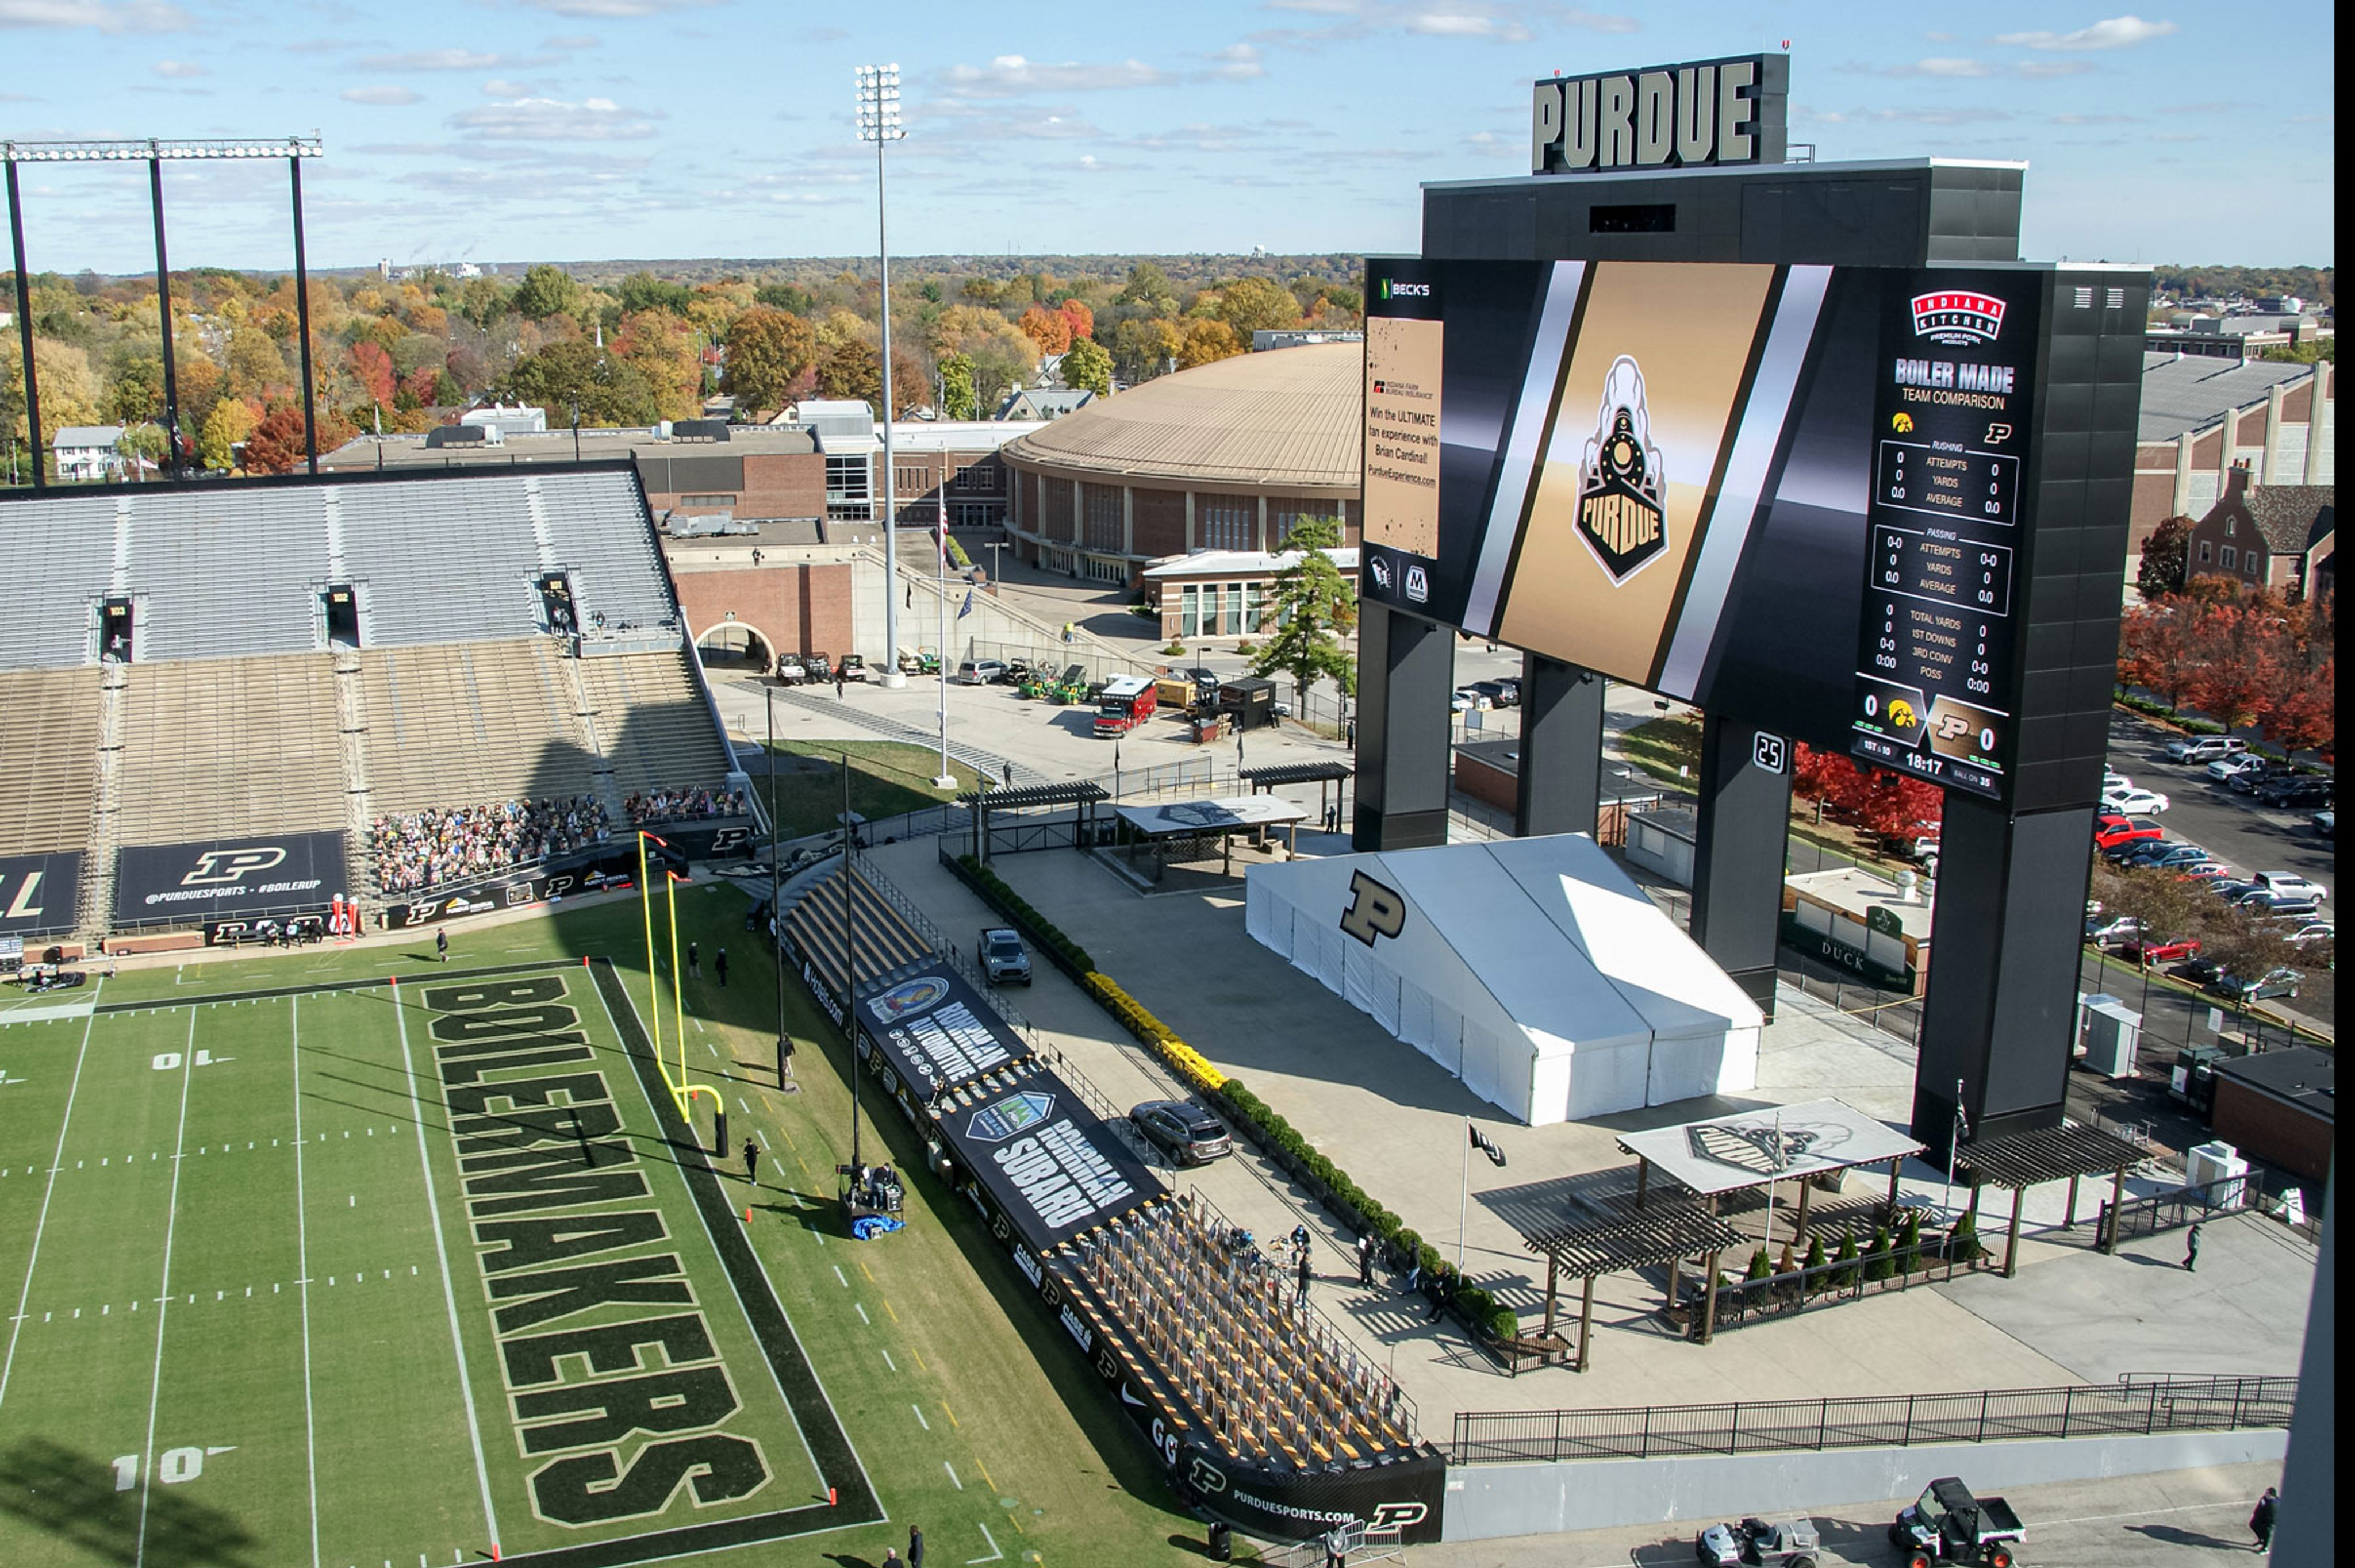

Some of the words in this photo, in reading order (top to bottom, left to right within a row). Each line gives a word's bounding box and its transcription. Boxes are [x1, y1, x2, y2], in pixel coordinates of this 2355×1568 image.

[1533, 61, 1754, 170] PURDUE
[1393, 284, 1429, 296] BECK'S
[1917, 297, 1997, 316] INDIANA
[1920, 314, 1995, 333] KITCHEN
[1895, 358, 1954, 388] BOILER
[1958, 363, 2014, 393] MADE
[1902, 388, 1931, 402] TEAM
[1932, 391, 2005, 410] COMPARISON
[1370, 406, 1383, 419] Win
[1384, 409, 1396, 421] the
[1398, 410, 1436, 427] ULTIMATE
[1381, 428, 1421, 444] experience
[1422, 434, 1438, 447] with
[1984, 423, 2012, 444] P
[1375, 444, 1394, 458] Brian
[1932, 440, 1963, 453] RUSHING
[1897, 451, 1905, 464] 0
[1926, 456, 1967, 471] ATTEMPTS
[1368, 464, 1436, 487] PurdueExperience.com
[1895, 469, 1903, 481] 0
[1991, 463, 1999, 476] 0
[1932, 476, 1958, 489] YARDS
[1990, 482, 1998, 495] 0
[1891, 486, 1906, 499] 0.0
[1926, 493, 1963, 508] AVERAGE
[1985, 501, 2001, 514] 0.0
[1583, 494, 1659, 555] PURDUE
[1887, 536, 1903, 549] 0-0
[1927, 528, 1956, 541] PASSING
[1919, 543, 1961, 559] ATTEMPTS
[1889, 554, 1897, 566] 0
[1980, 552, 1997, 567] 0-0
[1927, 562, 1953, 575] YARDS
[1885, 570, 1899, 584] 0.0
[1983, 572, 1991, 585] 0
[1919, 579, 1957, 595] AVERAGE
[1978, 590, 1994, 604] 0.0
[1886, 604, 1894, 616] 0
[1885, 621, 1893, 633] 0
[1910, 610, 1934, 625] TOTAL
[1935, 616, 1962, 631] YARDS
[1979, 625, 1986, 637] 0
[1880, 637, 1896, 651] 0-0
[1926, 632, 1957, 648] DOWNS
[1912, 647, 1928, 659] 3RD
[1929, 651, 1954, 664] CONV
[1977, 643, 1985, 656] 0
[1875, 654, 1897, 669] 0:00
[1971, 660, 1988, 675] 0-0
[1920, 666, 1942, 680] POSS
[1967, 677, 1990, 694] 0:00
[1864, 694, 1878, 717] 0
[1936, 714, 1970, 740] P
[1980, 728, 1995, 751] 0
[1758, 738, 1778, 766] 25
[1863, 740, 1878, 752] 1ST
[1882, 745, 1892, 756] 10
[1906, 752, 1943, 775] 18:17
[1979, 776, 1991, 787] 35
[180, 847, 286, 885] P
[145, 886, 246, 905] @PURDUESPORTS
[259, 879, 321, 894] #BOILERUP
[1340, 868, 1406, 948] P
[1821, 941, 1863, 971] DUCK
[932, 1001, 1010, 1070] ROHRMAN
[906, 1016, 976, 1082] AUTOMOTIVE
[1035, 1119, 1134, 1208] ROHRMAN
[993, 1137, 1096, 1228] SUBARU
[420, 974, 774, 1528] BOILERMAKERS
[1016, 1243, 1037, 1273] CASE
[1063, 1304, 1086, 1336] CASE
[112, 1446, 204, 1491] 10
[1188, 1456, 1227, 1494] P
[1234, 1489, 1355, 1523] PURDUESPORTS.COM
[1364, 1502, 1428, 1534] P
